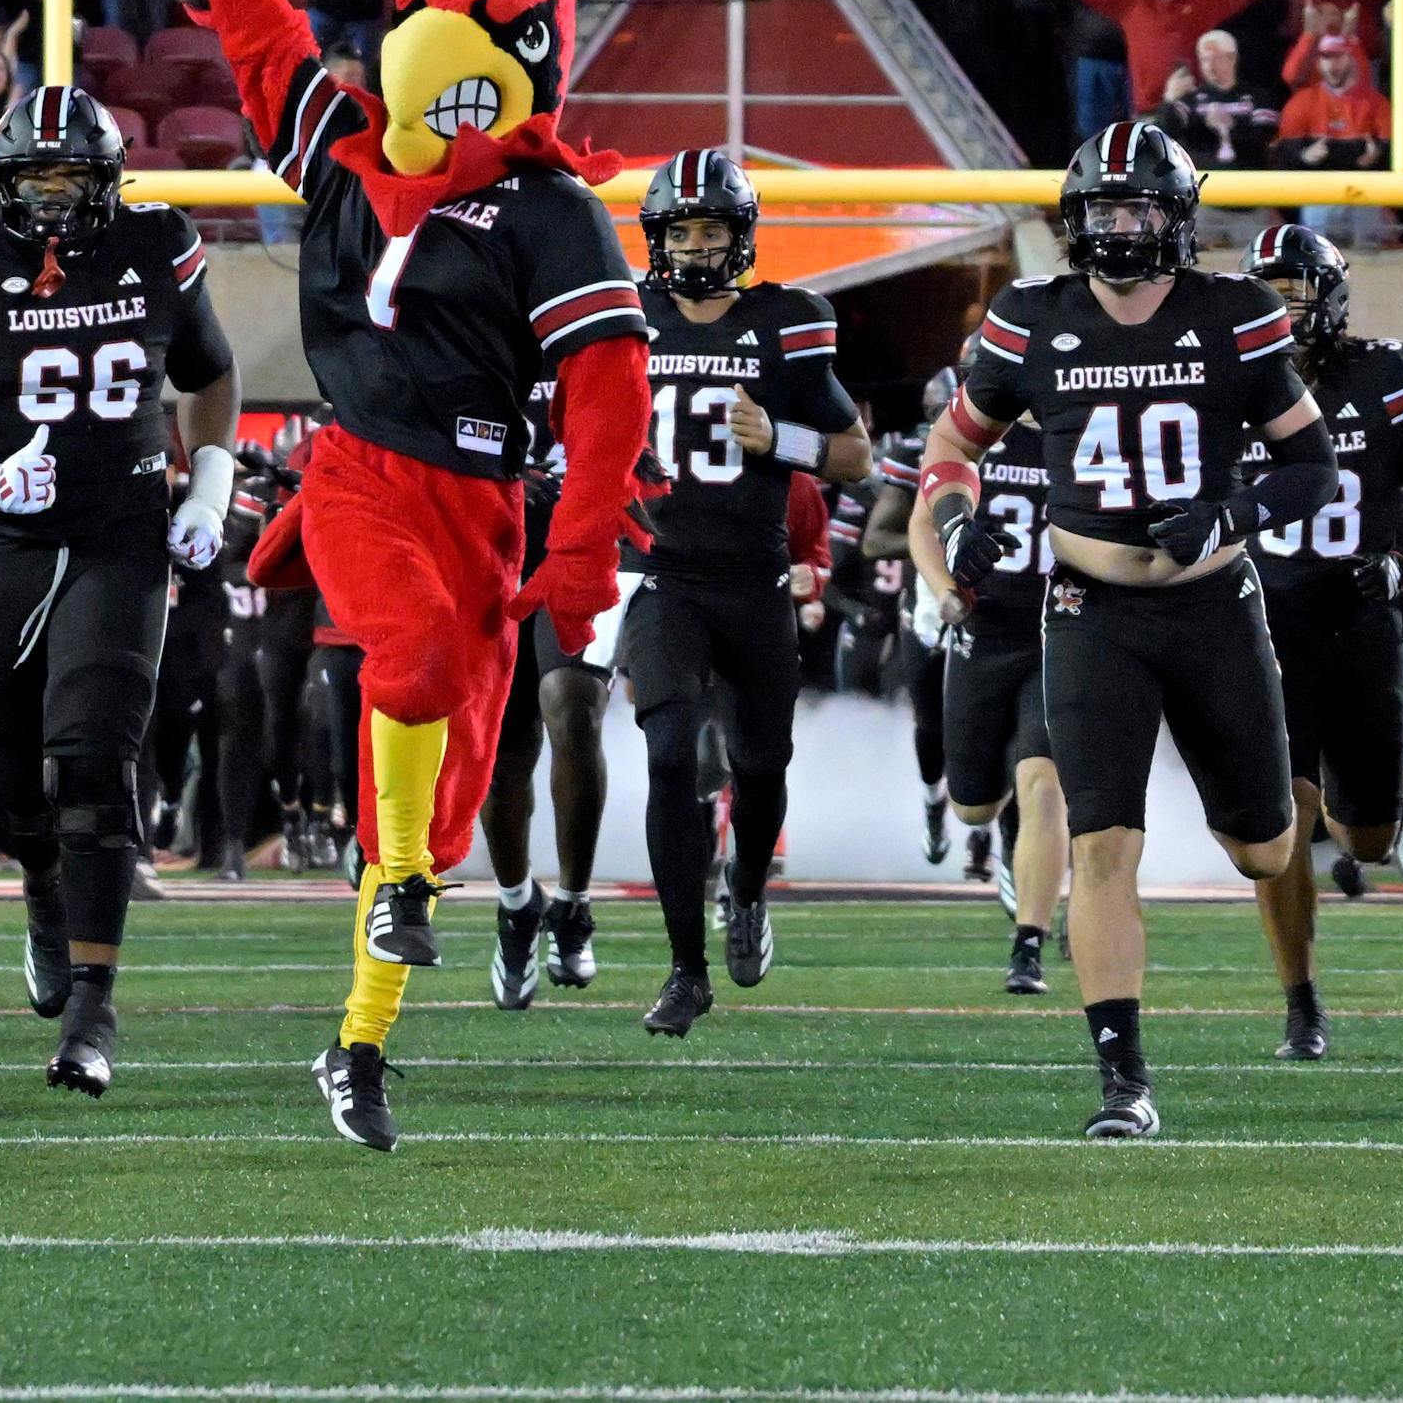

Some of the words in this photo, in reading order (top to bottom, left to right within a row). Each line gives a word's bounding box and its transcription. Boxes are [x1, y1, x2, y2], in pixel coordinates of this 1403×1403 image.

[8, 296, 146, 331] LOUISVILLE
[18, 340, 148, 423] 66
[646, 355, 761, 378] OUISVILLE
[1056, 362, 1205, 391] LOUISVILLE
[652, 384, 744, 484] 13
[1073, 401, 1202, 509] 40
[984, 463, 1051, 485] LOUISV
